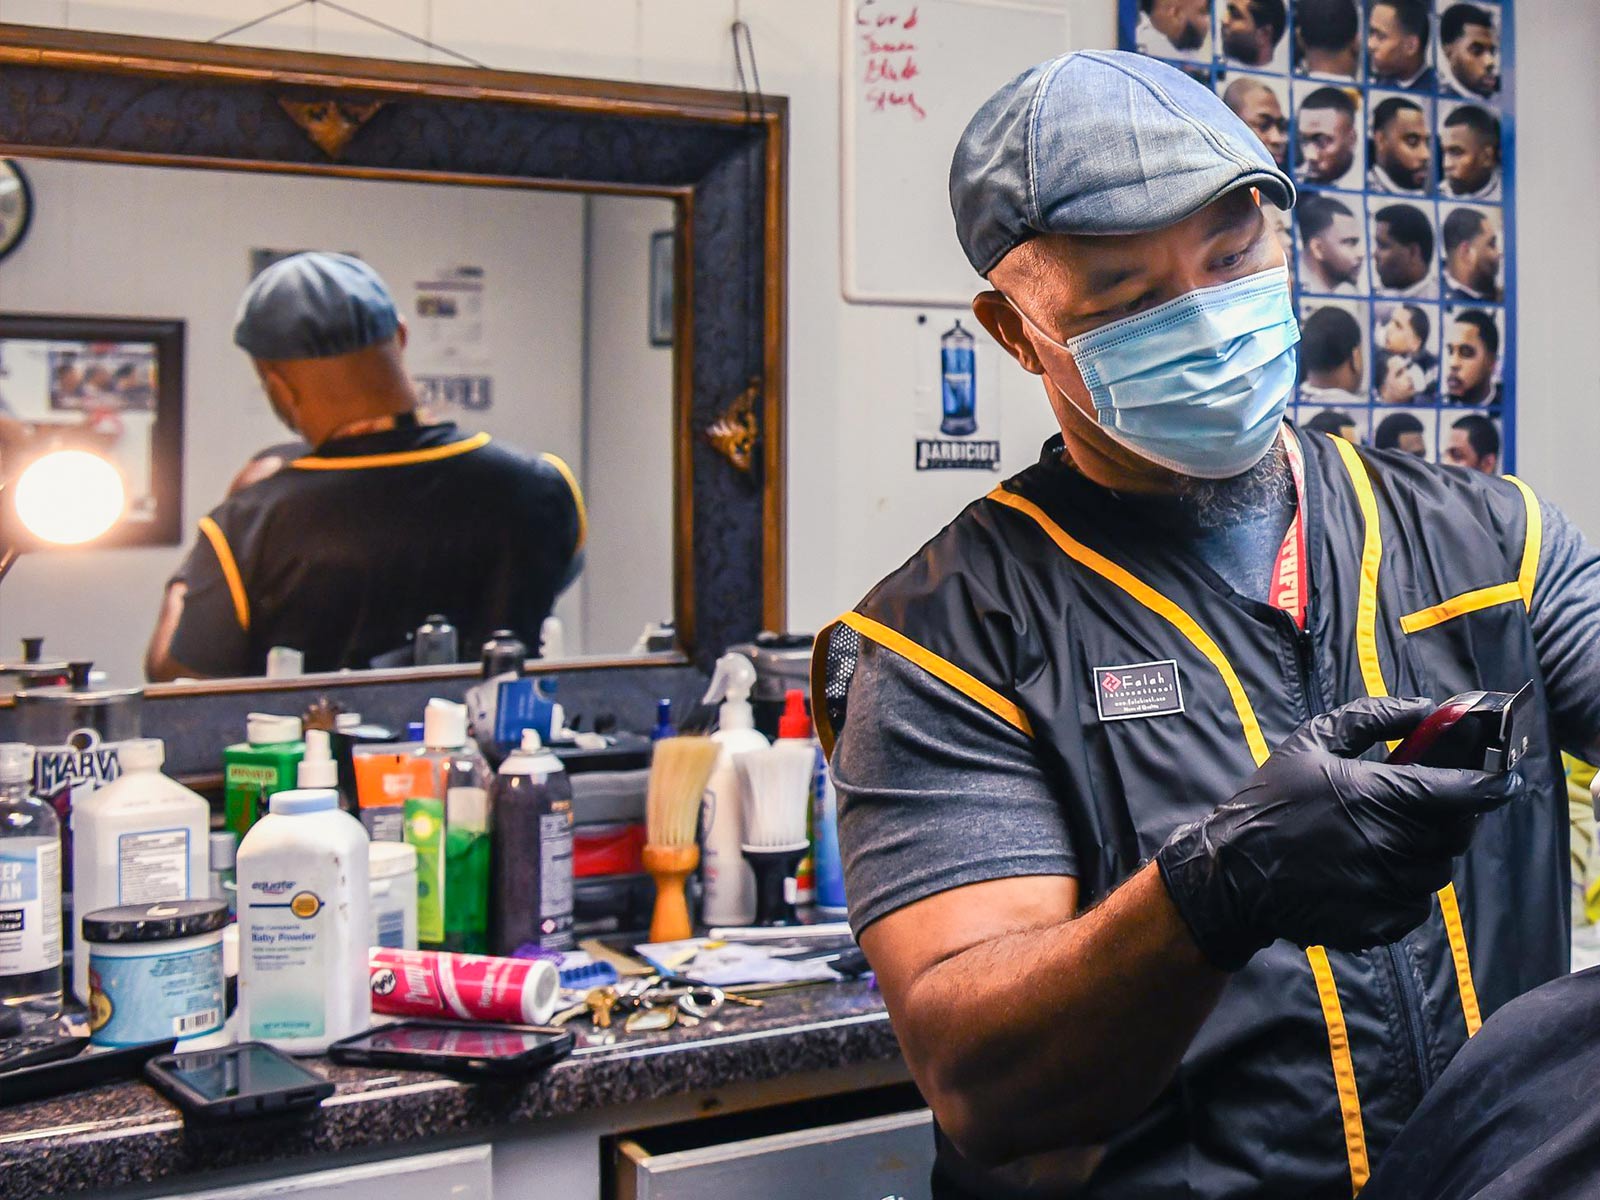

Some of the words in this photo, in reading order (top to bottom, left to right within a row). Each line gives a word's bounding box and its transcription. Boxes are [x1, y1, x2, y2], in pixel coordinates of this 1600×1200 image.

[1122, 671, 1165, 690] Falah
[251, 932, 275, 944] Baby
[278, 931, 316, 943] Powder
